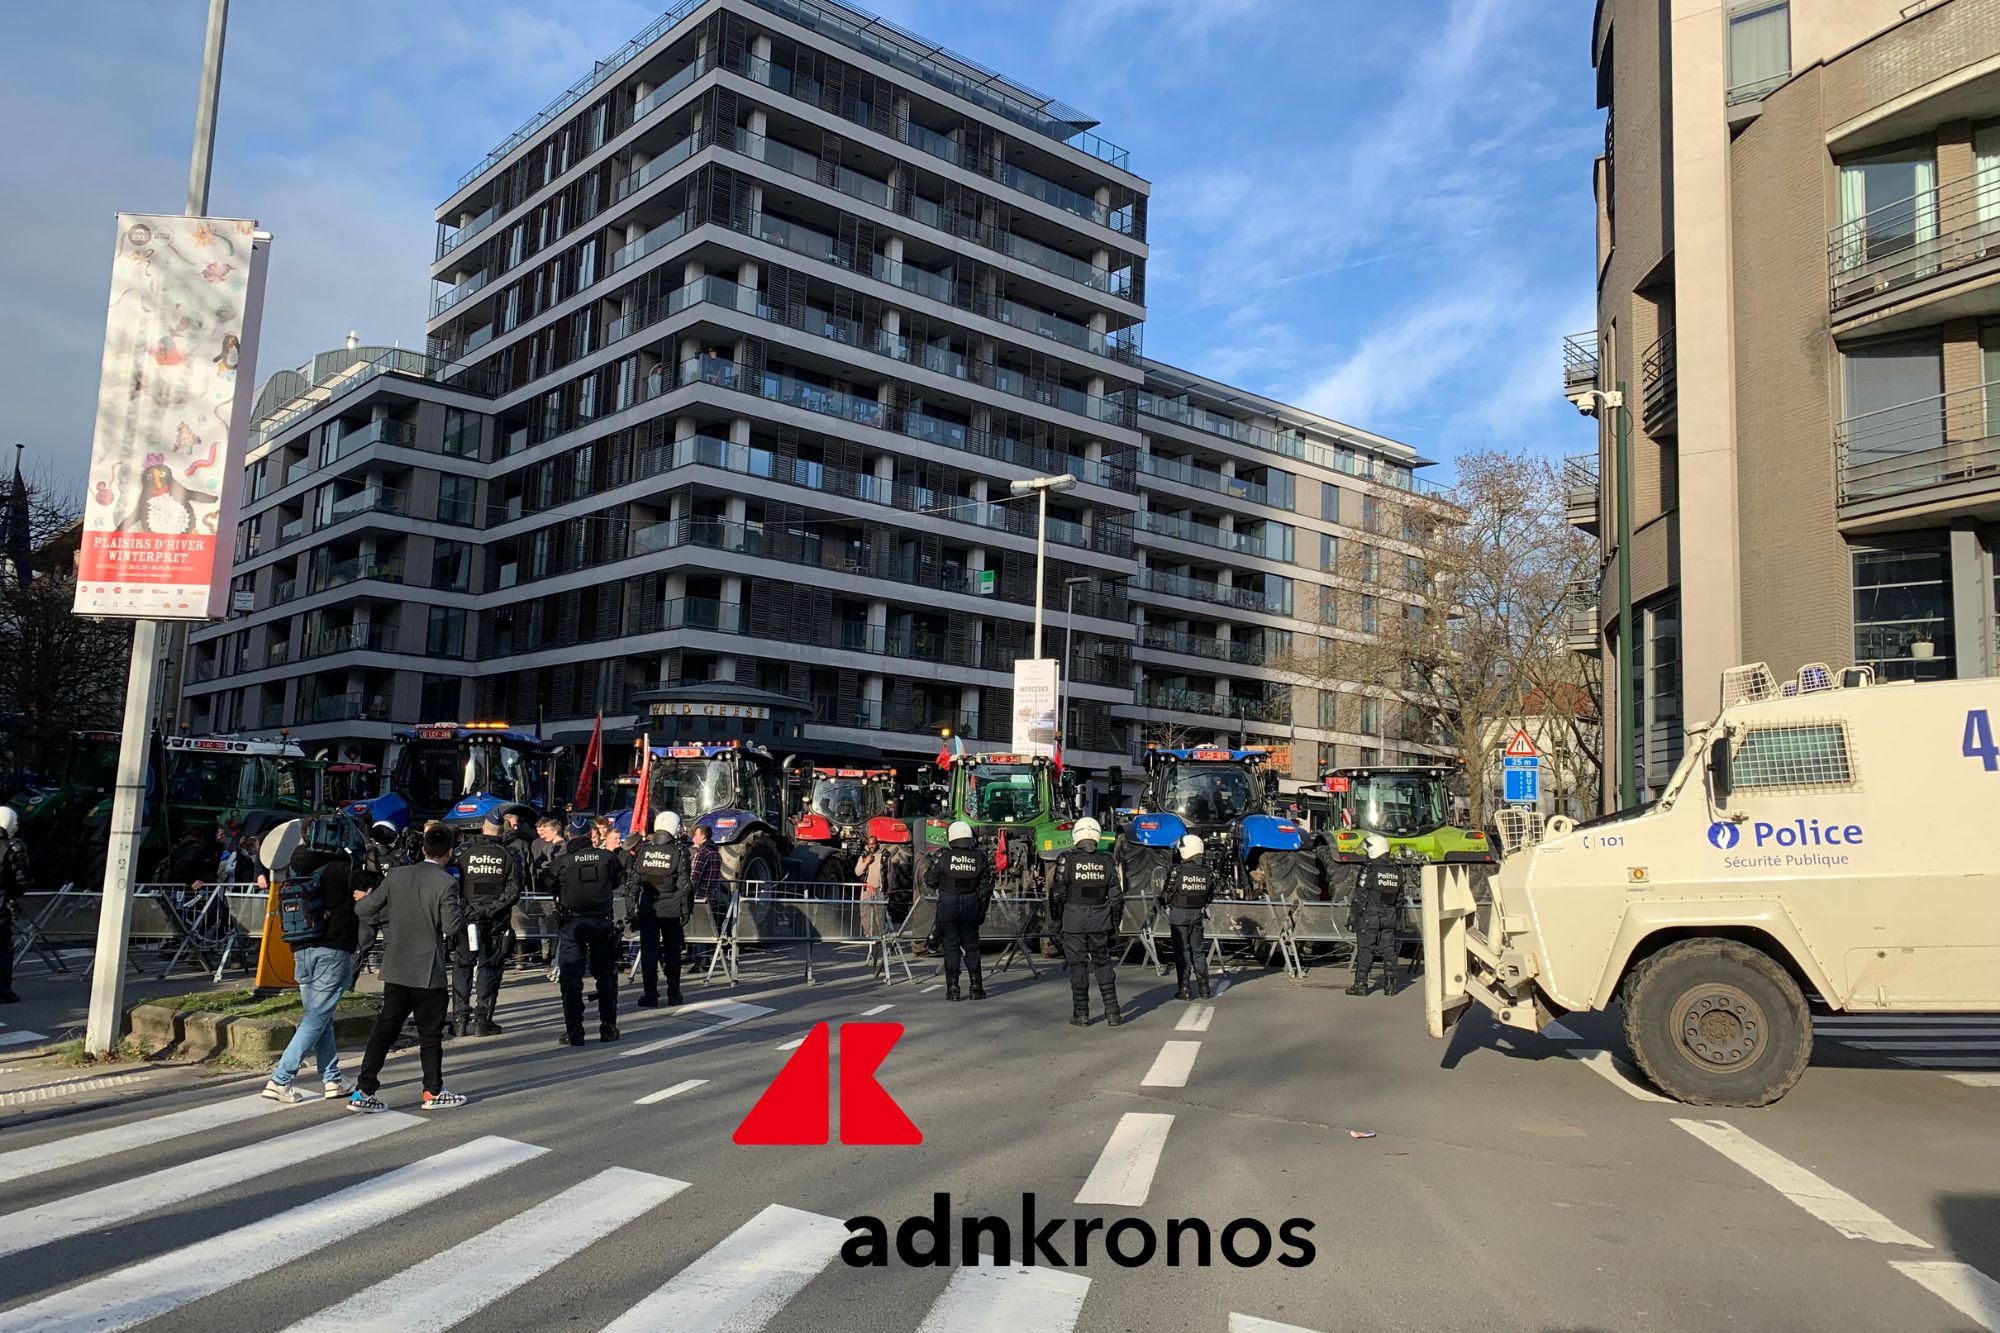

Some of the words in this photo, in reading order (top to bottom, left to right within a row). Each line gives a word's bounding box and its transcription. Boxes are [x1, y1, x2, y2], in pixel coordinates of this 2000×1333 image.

[93, 537, 152, 550] PLAISIRS
[155, 538, 205, 551] D'HIVER
[108, 550, 189, 563] WINTERPRET
[1019, 685, 1049, 693] MERCEDES
[651, 703, 693, 716] WILD
[703, 705, 764, 718] GEESE
[1962, 709, 2000, 771] 4
[1754, 818, 1863, 848] Police
[1600, 836, 1624, 847] 101
[469, 855, 503, 865] Police
[574, 853, 600, 863] Politie
[645, 851, 671, 860] Police
[951, 855, 976, 864] Police
[1724, 854, 1782, 868] Sécurité
[1786, 853, 1849, 868] Publique
[643, 859, 671, 869] Politie
[950, 863, 977, 872] Politie
[1075, 862, 1104, 871] Police
[467, 865, 503, 875] Politie
[1075, 871, 1105, 880] Politie
[1183, 875, 1206, 884] Police
[1377, 872, 1399, 880] Politie
[1181, 883, 1207, 891] Politie
[1378, 879, 1399, 887] Police
